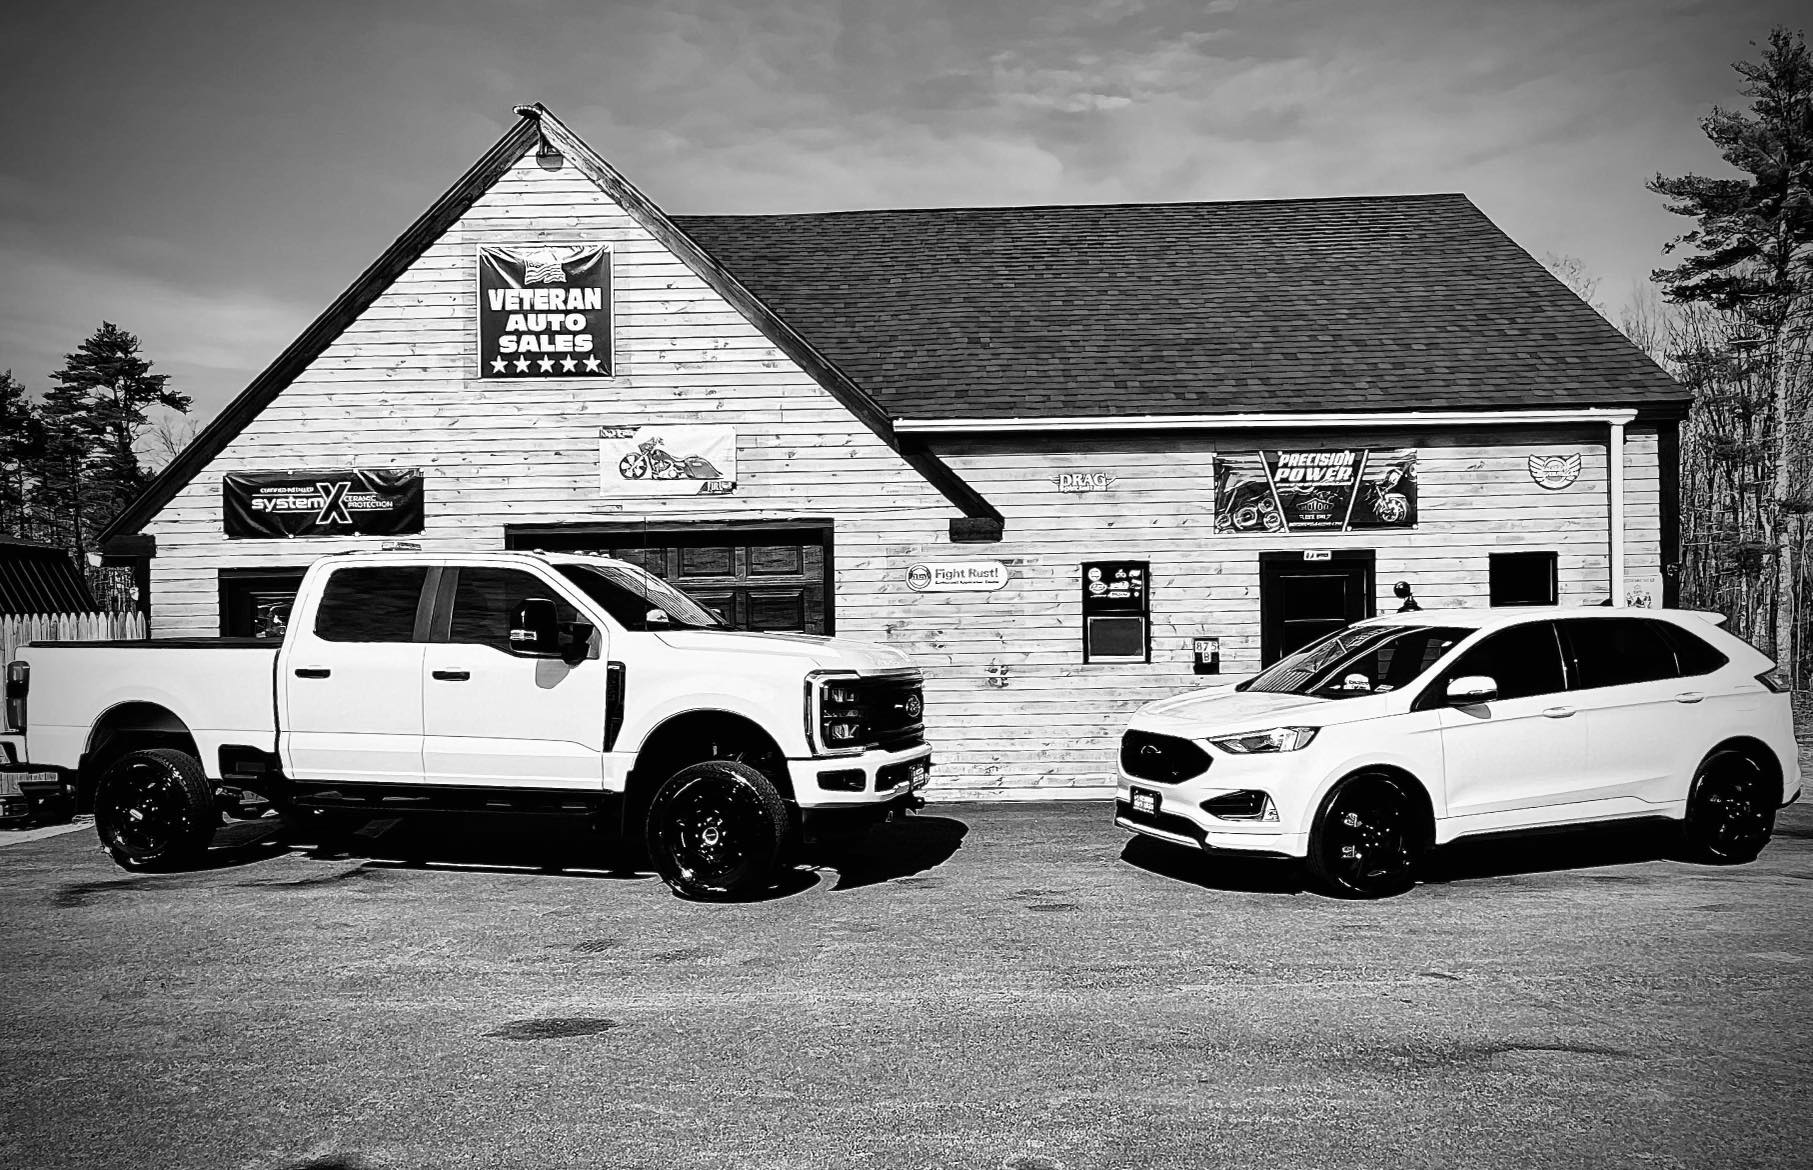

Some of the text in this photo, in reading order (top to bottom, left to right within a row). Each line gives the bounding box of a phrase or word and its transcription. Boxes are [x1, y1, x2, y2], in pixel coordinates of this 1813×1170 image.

[488, 287, 602, 311] VETERAN
[505, 313, 587, 332] AUTO
[498, 334, 594, 353] SALES
[1278, 452, 1356, 467] PRECISION
[1059, 473, 1106, 487] DRAG
[1274, 466, 1353, 482] POWER
[935, 568, 965, 580] Fight
[968, 567, 998, 578] Rust!
[1196, 641, 1217, 651] 875
